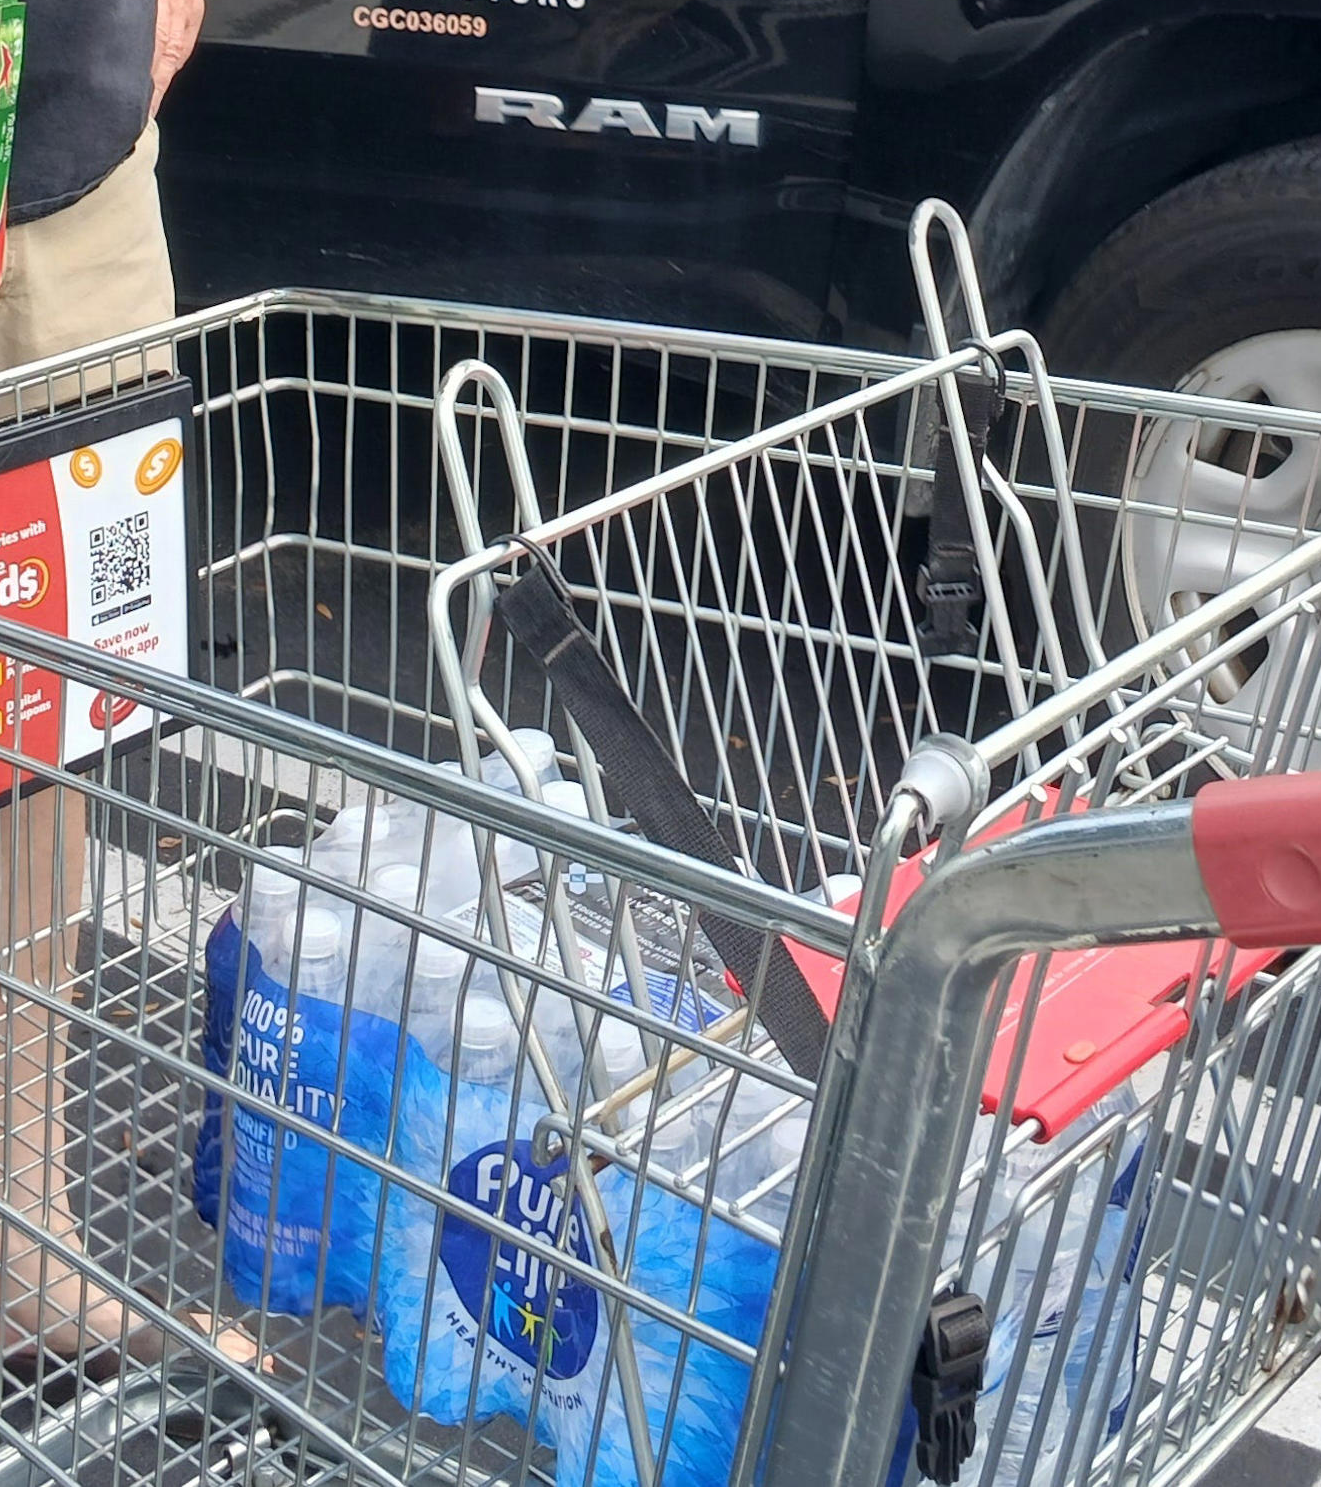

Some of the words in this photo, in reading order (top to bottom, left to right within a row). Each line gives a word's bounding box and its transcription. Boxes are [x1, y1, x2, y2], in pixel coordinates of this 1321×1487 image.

[353, 5, 488, 38] CGC036059
[474, 86, 761, 147] RAM
[20, 520, 47, 540] with
[93, 634, 122, 651] Save
[124, 622, 150, 641] now
[137, 636, 159, 653] app
[243, 989, 304, 1045] 100%
[238, 1026, 300, 1079] PURE
[234, 1105, 298, 1150] PURIFID
[446, 1311, 518, 1374] HEATHY
